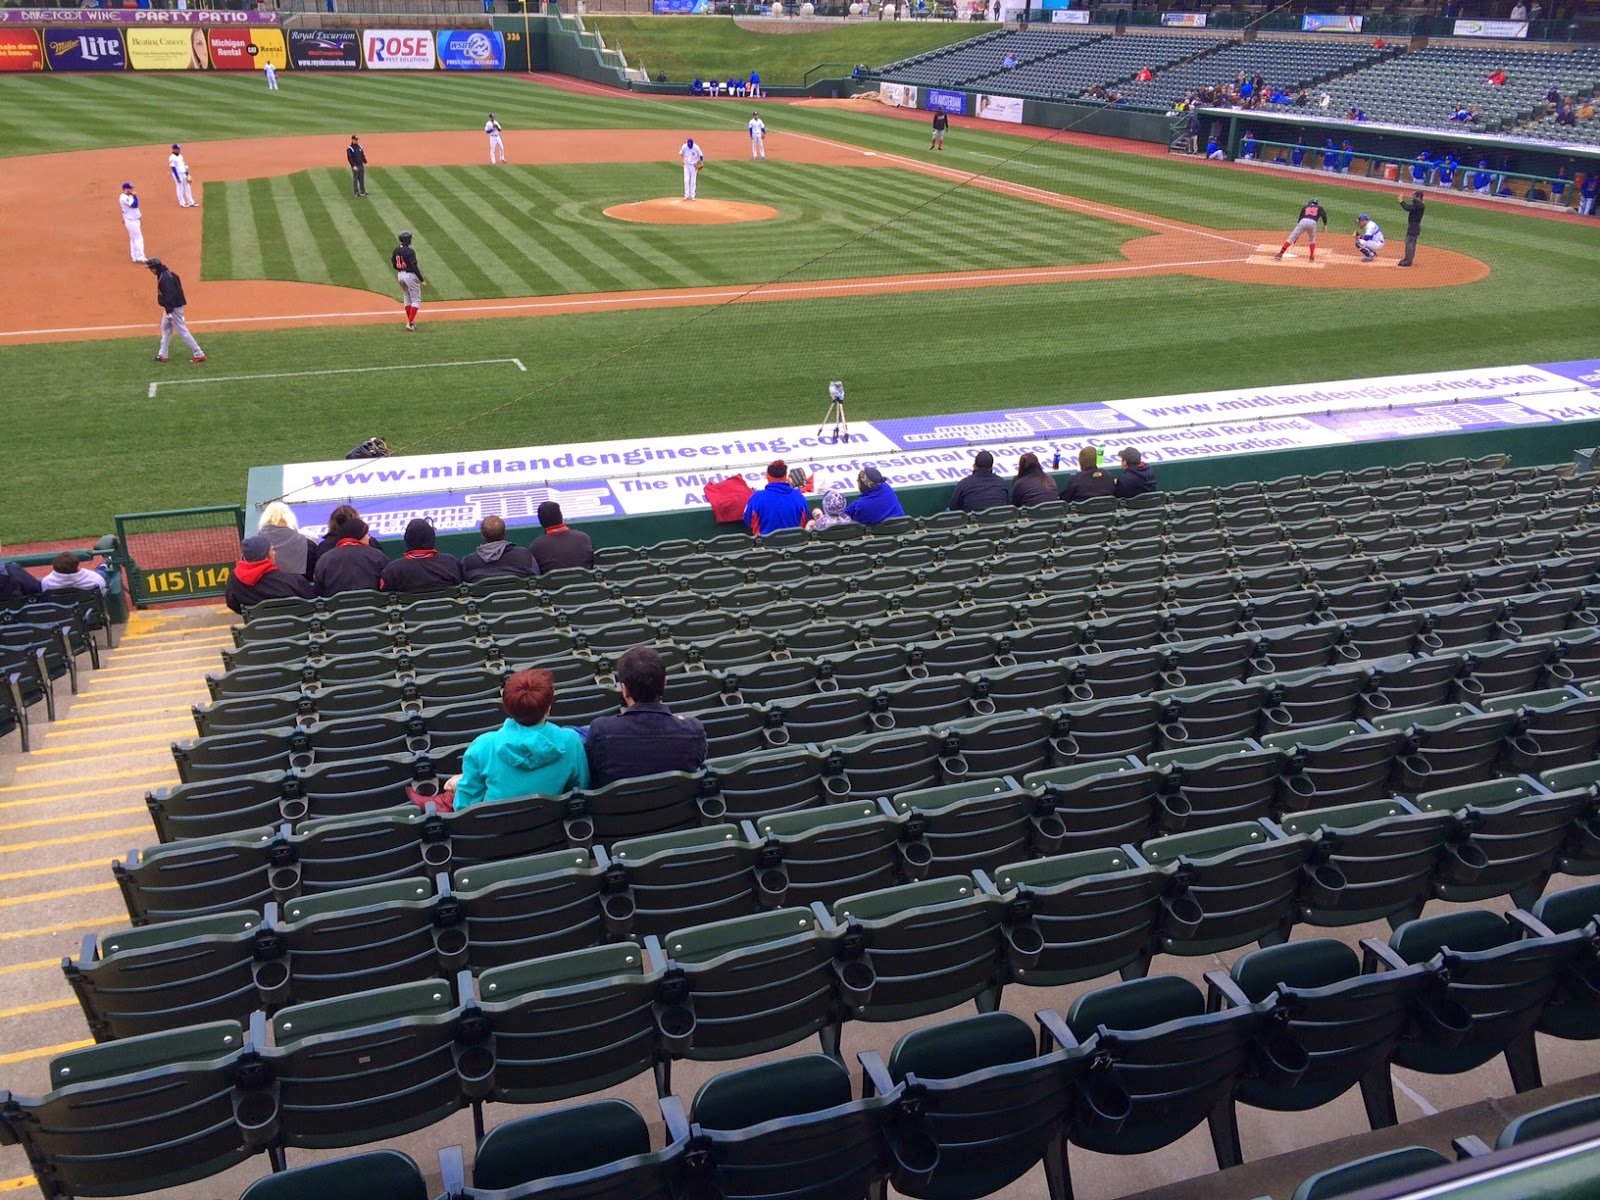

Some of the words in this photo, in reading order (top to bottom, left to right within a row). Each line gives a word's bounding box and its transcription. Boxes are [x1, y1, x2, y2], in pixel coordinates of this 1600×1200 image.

[87, 11, 121, 21] WINE
[135, 11, 192, 21] PARTY
[199, 11, 248, 21] PATIO
[291, 31, 314, 41] Royal
[316, 31, 355, 40] Excursion
[507, 33, 520, 41] 336
[132, 38, 159, 46] Beating
[211, 38, 245, 48] Michigan
[50, 40, 80, 56] Miller
[78, 36, 120, 61] Lite
[217, 48, 241, 56] Rental
[368, 37, 428, 62] ROSE
[1143, 374, 1548, 417] www.midlandengineering.com
[1548, 407, 1586, 418] 24
[312, 433, 870, 487] www.midlandengineering.com
[619, 478, 669, 493] The
[808, 449, 964, 473] Professional
[1049, 441, 1083, 452] for
[1087, 428, 1221, 448] Commercial
[935, 462, 1009, 479] Meal
[1161, 436, 1302, 458] Restoration.
[147, 571, 185, 593] 115
[196, 567, 230, 588] 114
